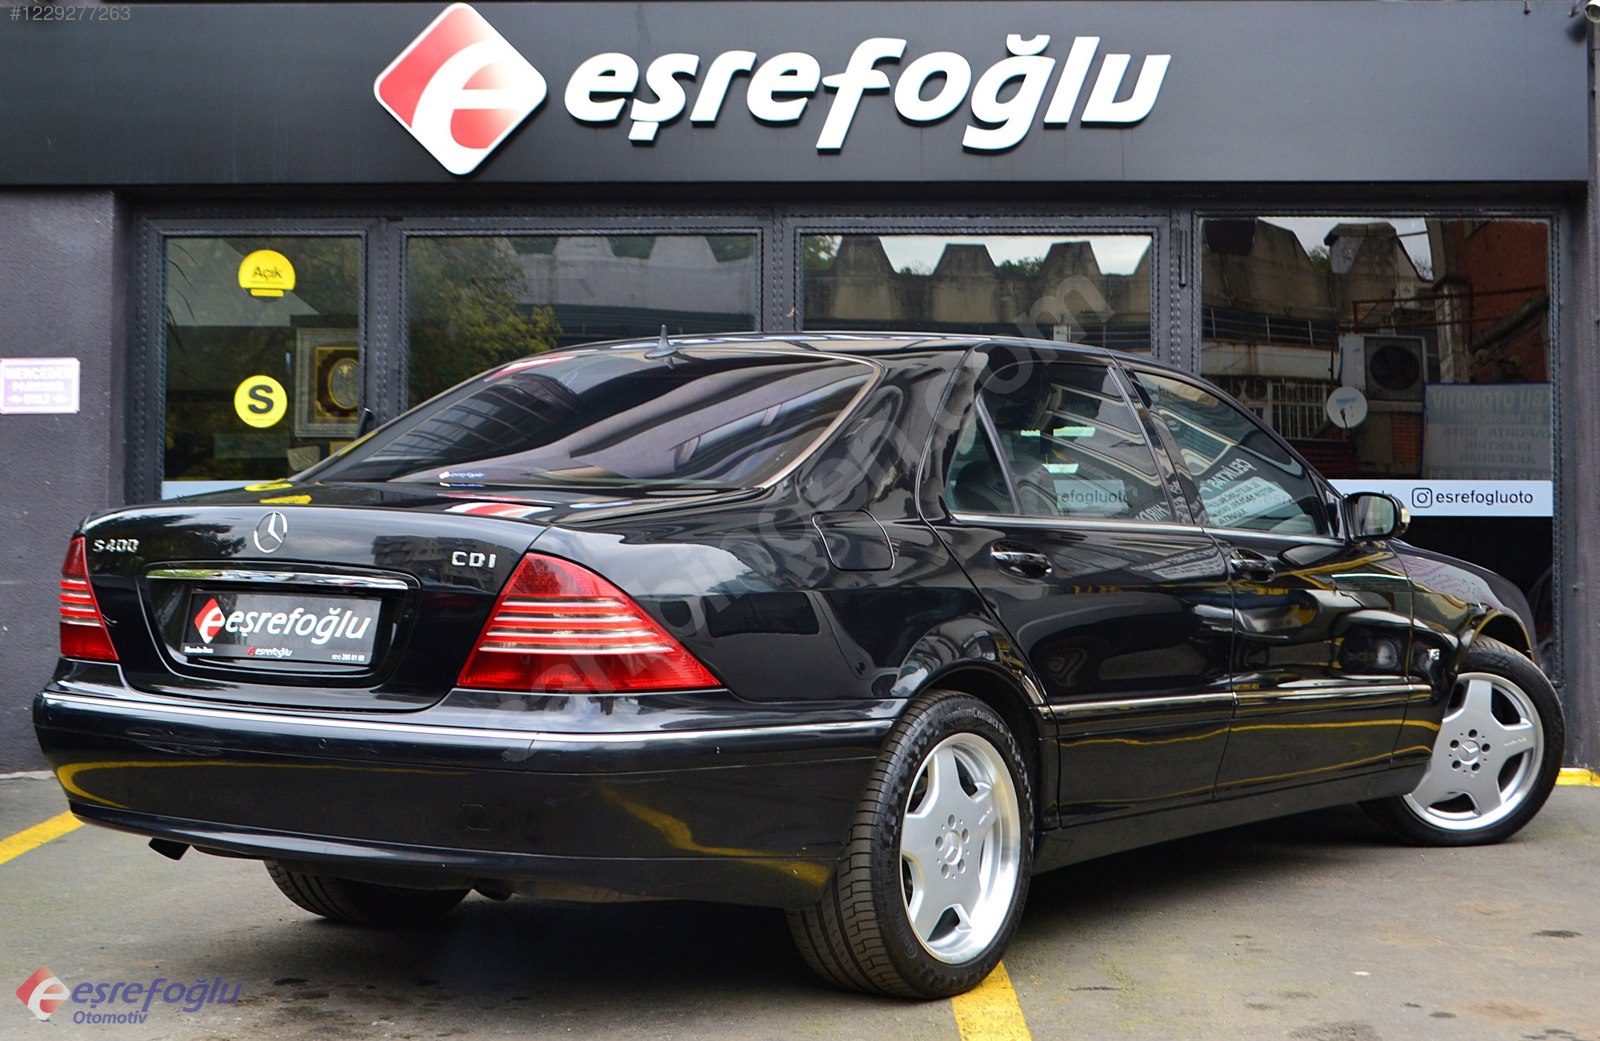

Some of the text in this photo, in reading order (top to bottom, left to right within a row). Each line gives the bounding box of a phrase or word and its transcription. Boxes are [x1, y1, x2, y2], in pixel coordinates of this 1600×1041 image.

[563, 34, 1173, 152] eşrefoğlu
[252, 266, 283, 281] Açık
[247, 384, 275, 414] S
[1436, 490, 1533, 505] esrefogluoto
[93, 538, 139, 552] S400
[451, 551, 497, 568] CDI
[225, 607, 371, 645] eşrefoğlu
